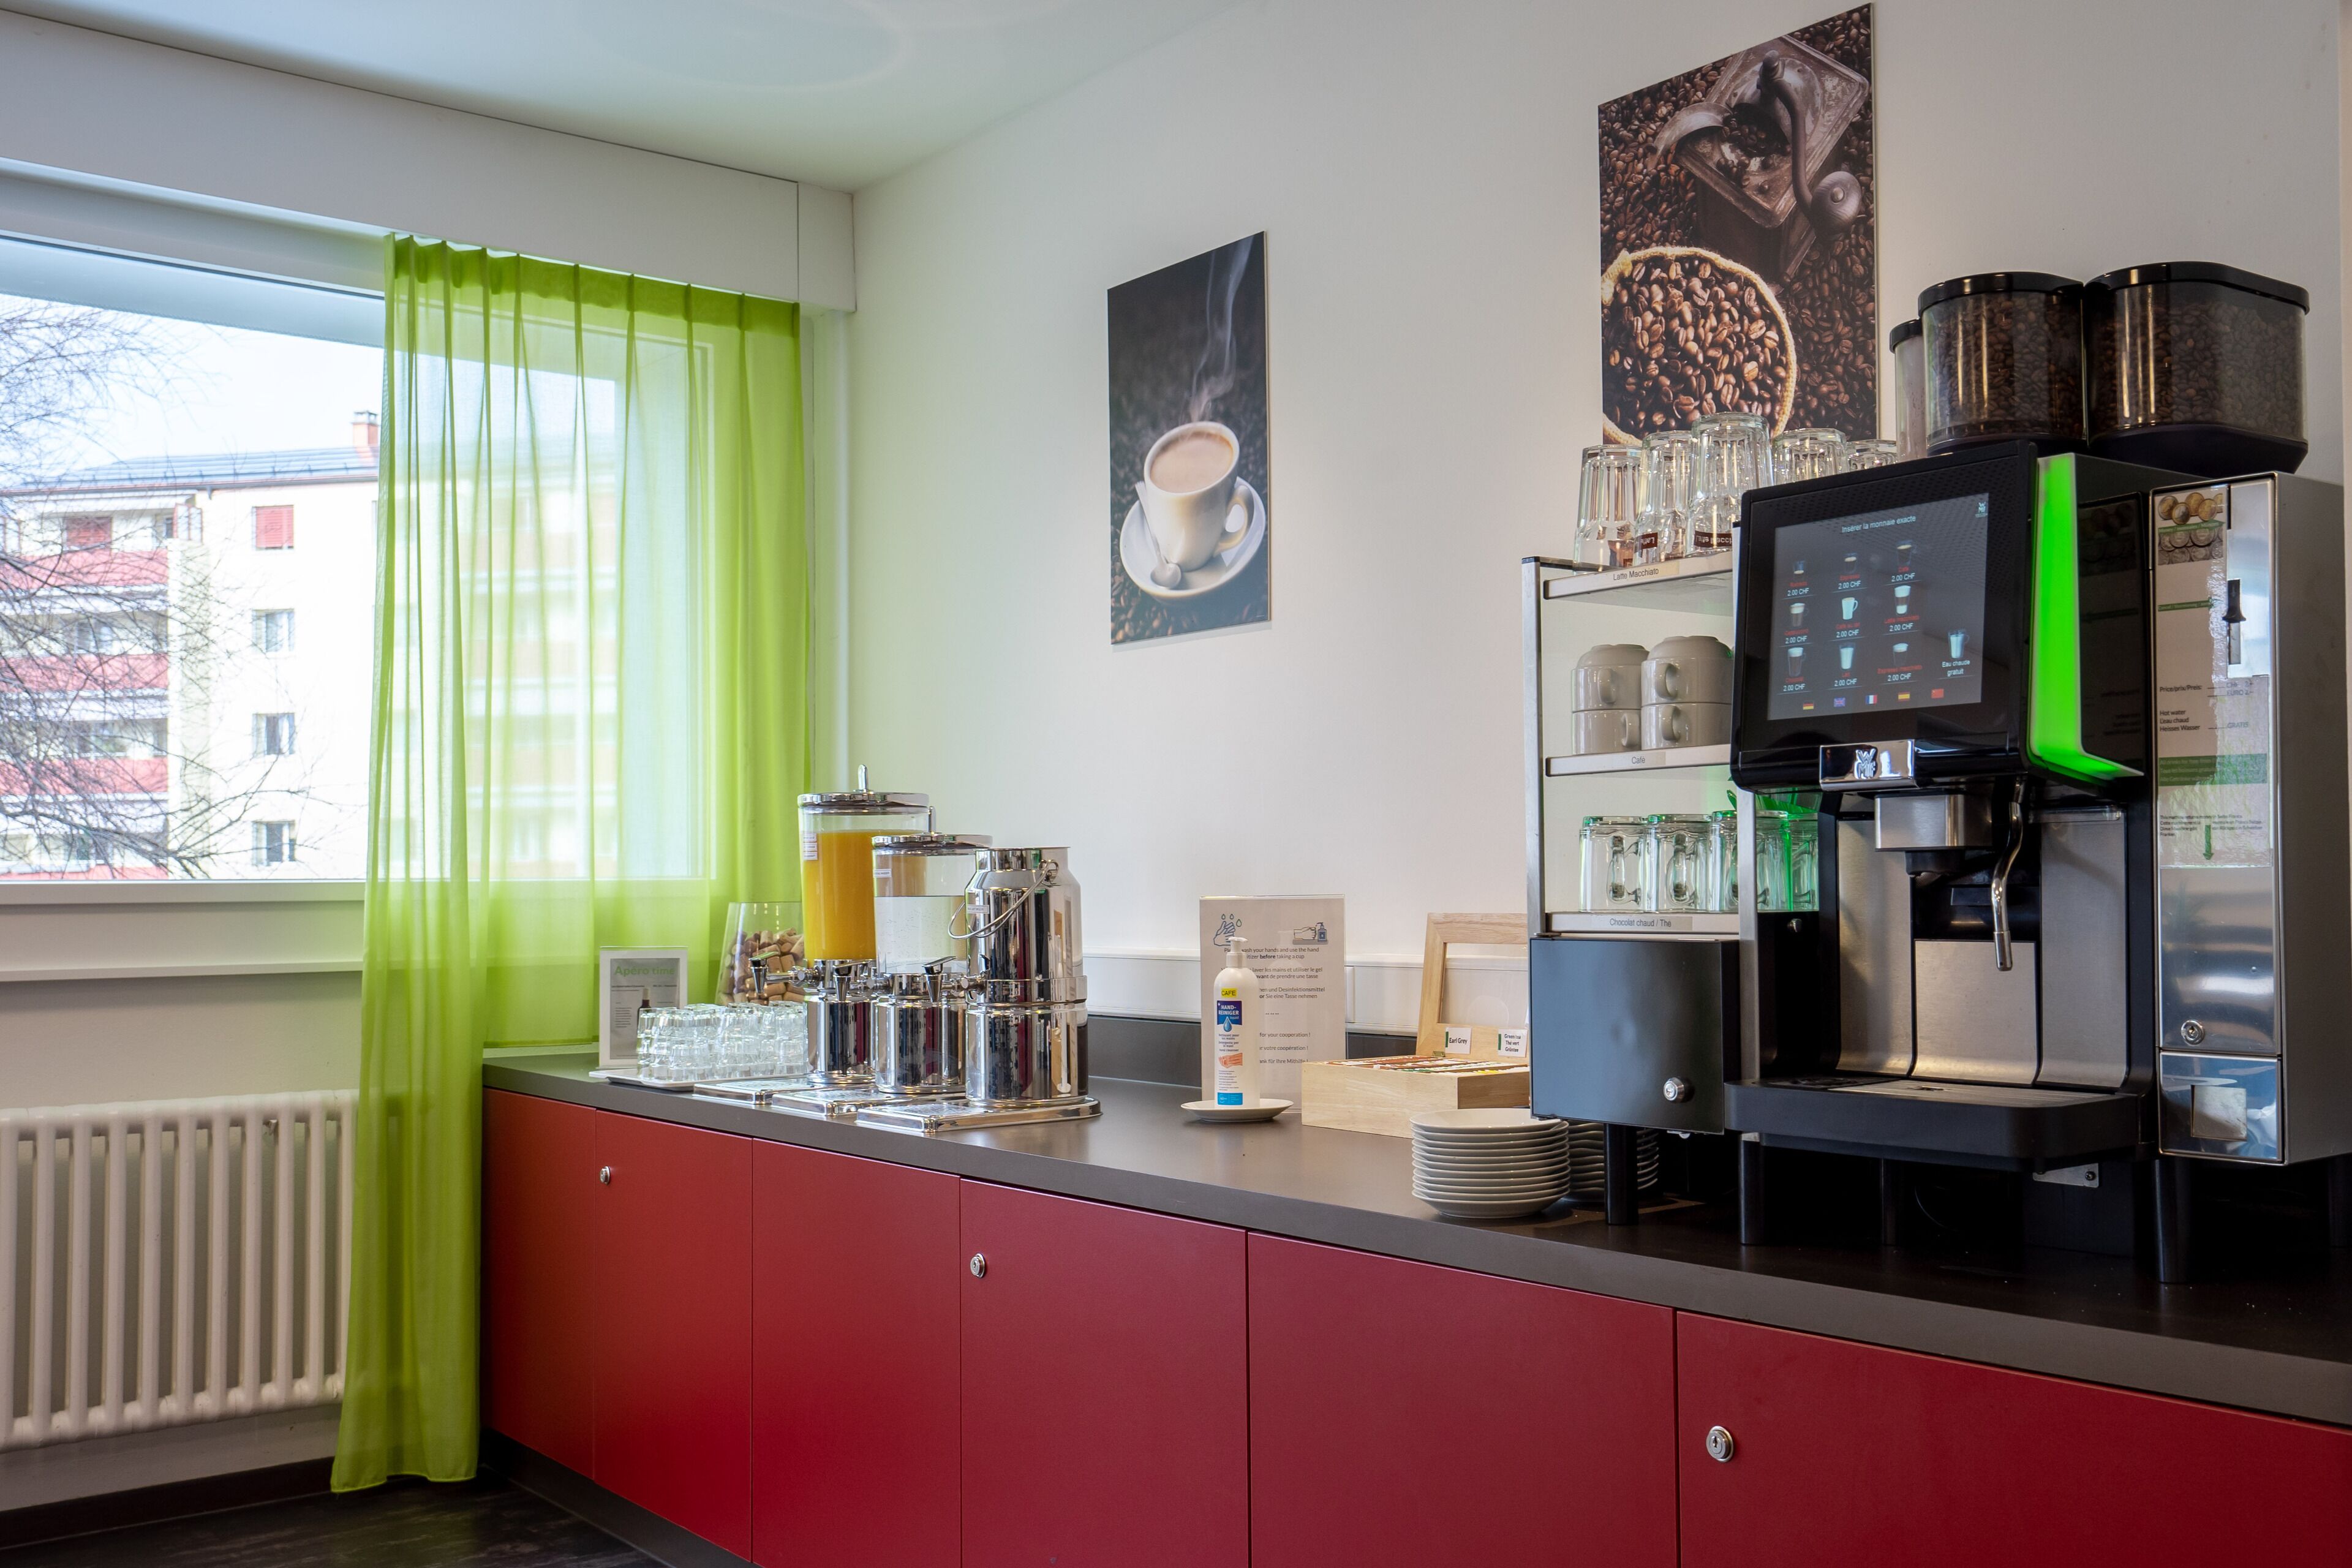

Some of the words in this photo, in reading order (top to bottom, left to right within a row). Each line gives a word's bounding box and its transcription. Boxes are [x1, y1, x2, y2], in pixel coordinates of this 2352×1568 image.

[1842, 524, 1861, 533] Insérer
[1870, 519, 1895, 528] monnaie
[1896, 515, 1916, 524] exacte
[1629, 568, 1659, 579] Macchiato
[1947, 668, 1964, 677] gratuit
[1631, 756, 1646, 764] Café
[1854, 748, 1877, 780] WMF
[615, 966, 649, 977] Apéro
